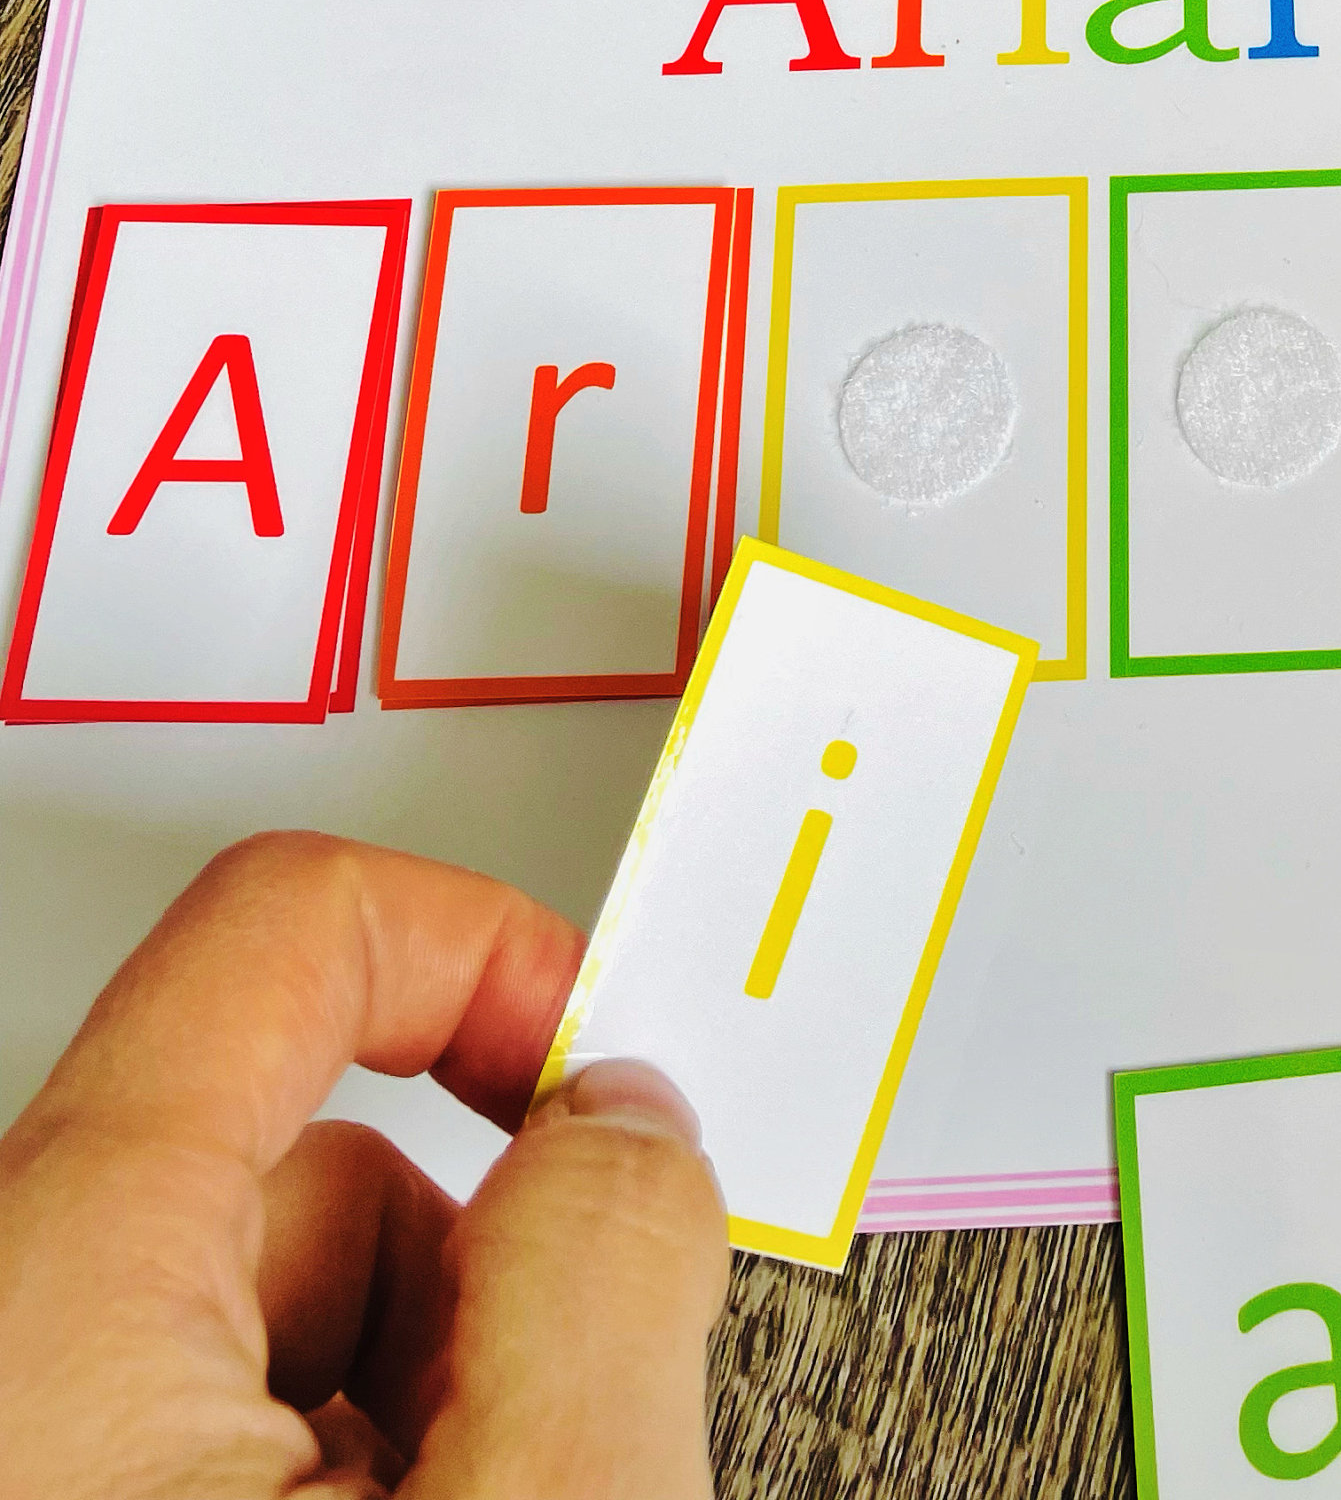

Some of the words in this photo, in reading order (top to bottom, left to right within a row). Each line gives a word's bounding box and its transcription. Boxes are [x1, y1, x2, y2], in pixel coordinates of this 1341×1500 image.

[106, 333, 286, 539] A
[518, 361, 617, 515] r
[743, 739, 859, 1000] i
